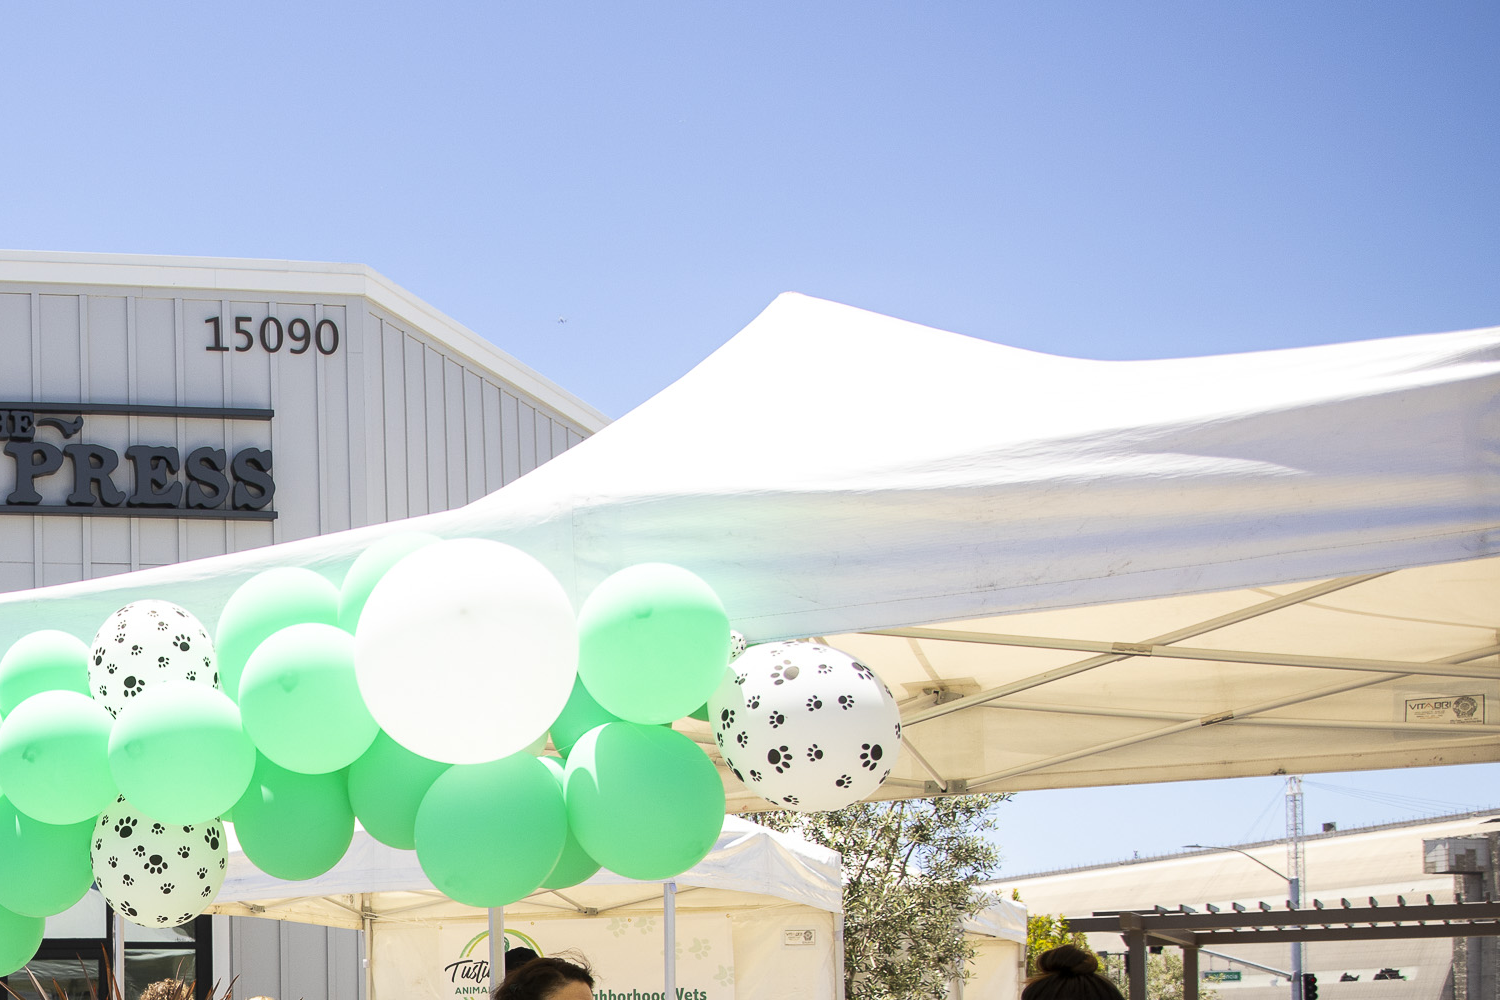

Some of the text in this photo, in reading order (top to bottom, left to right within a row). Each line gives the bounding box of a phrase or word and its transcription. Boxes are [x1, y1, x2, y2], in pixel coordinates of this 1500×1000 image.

[204, 315, 340, 355] 15090
[3, 440, 276, 510] PRESS
[444, 959, 490, 984] Tusti
[454, 986, 491, 995] ANIMA
